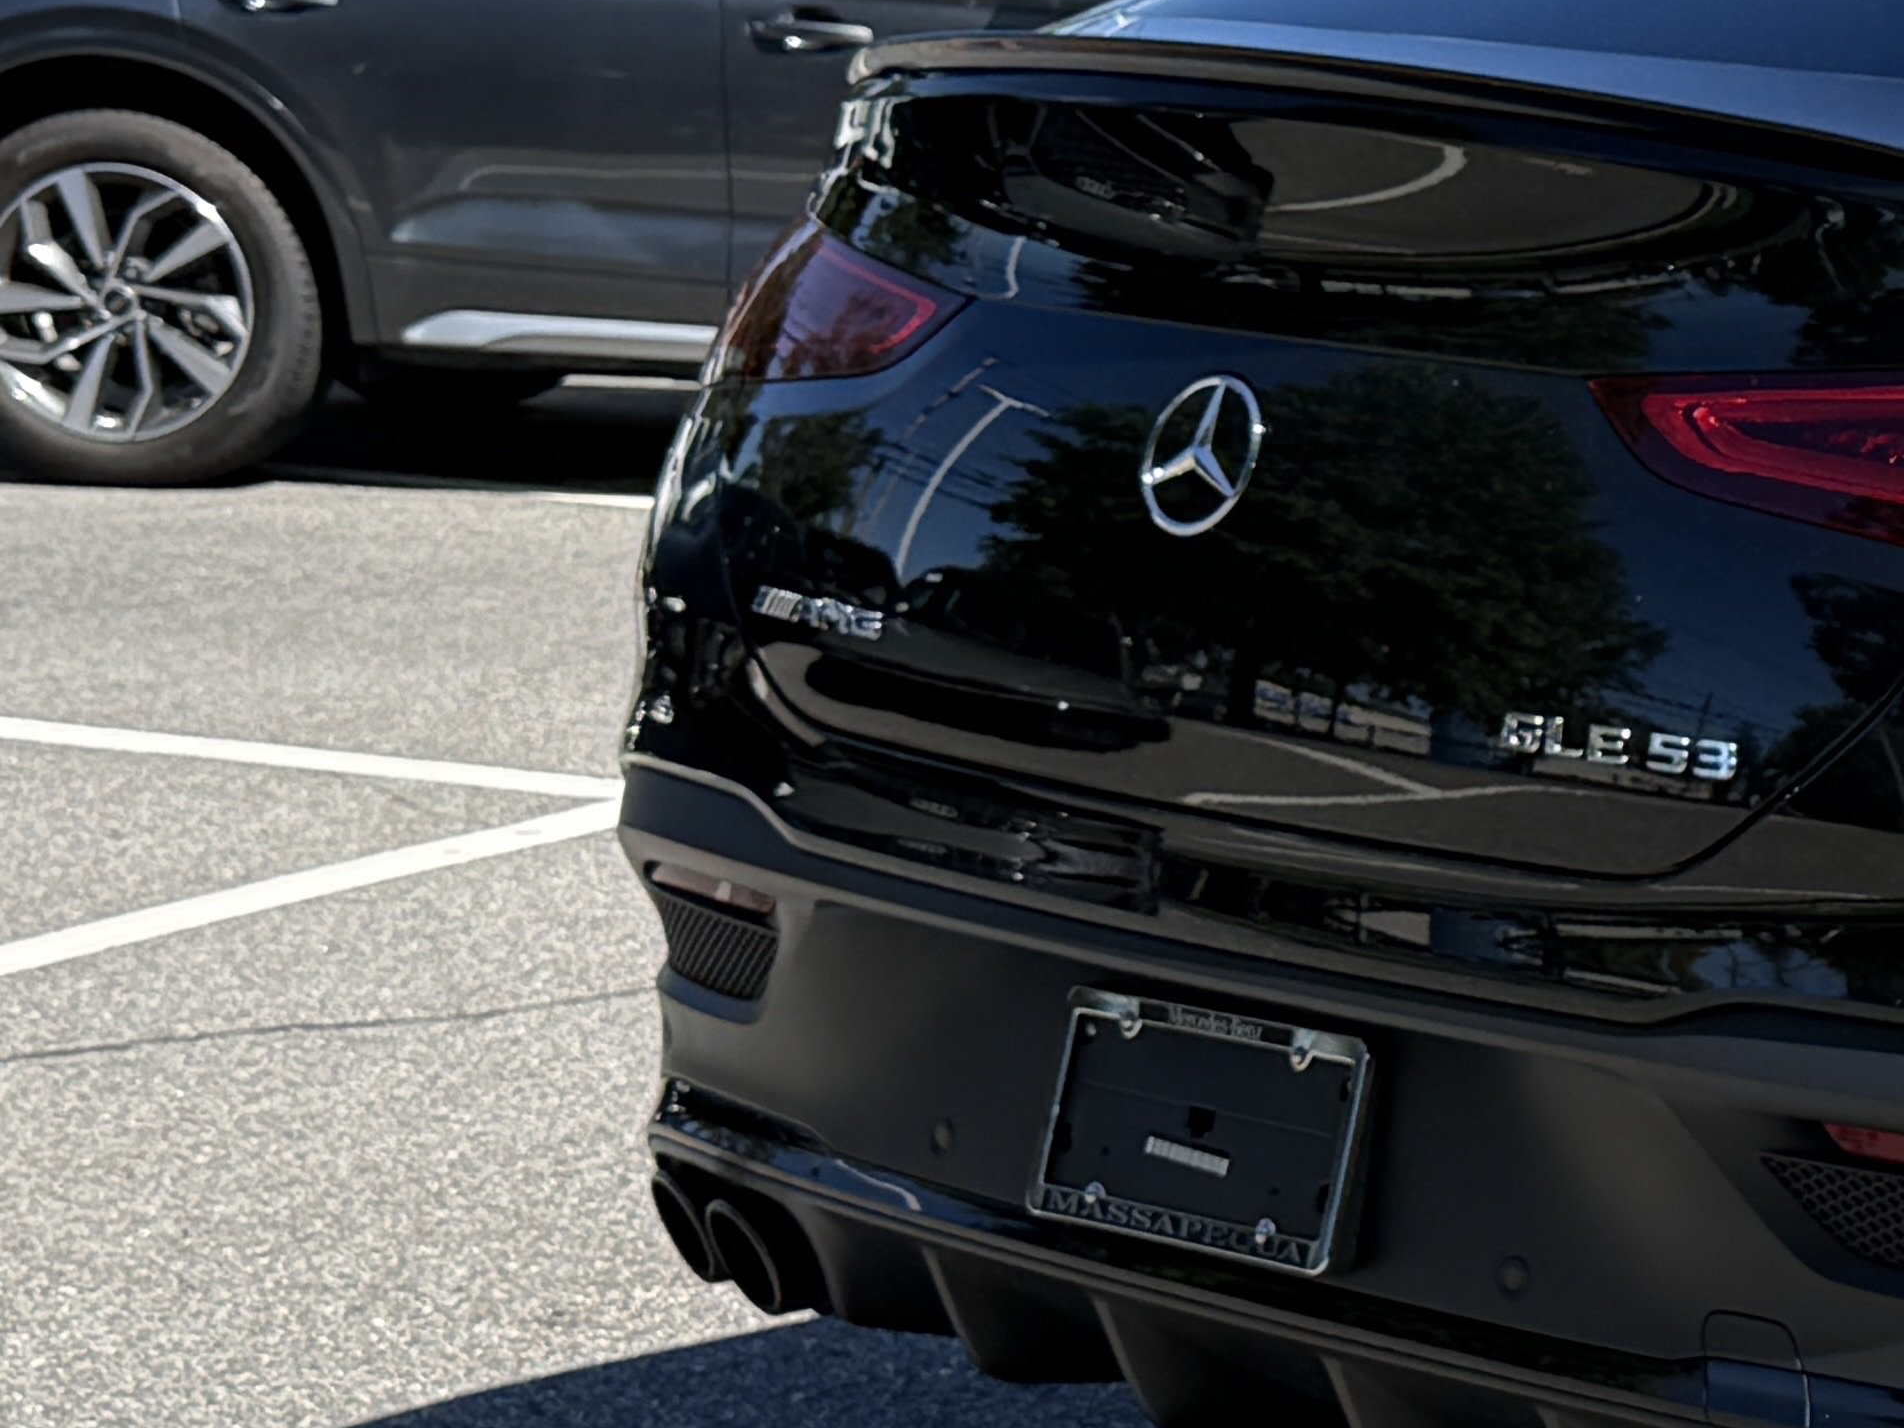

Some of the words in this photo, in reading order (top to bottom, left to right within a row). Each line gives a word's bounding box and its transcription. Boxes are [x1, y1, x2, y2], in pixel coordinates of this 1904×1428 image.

[794, 596, 884, 640] AMG
[1501, 712, 1632, 765] GLE
[1646, 732, 1738, 780] 53
